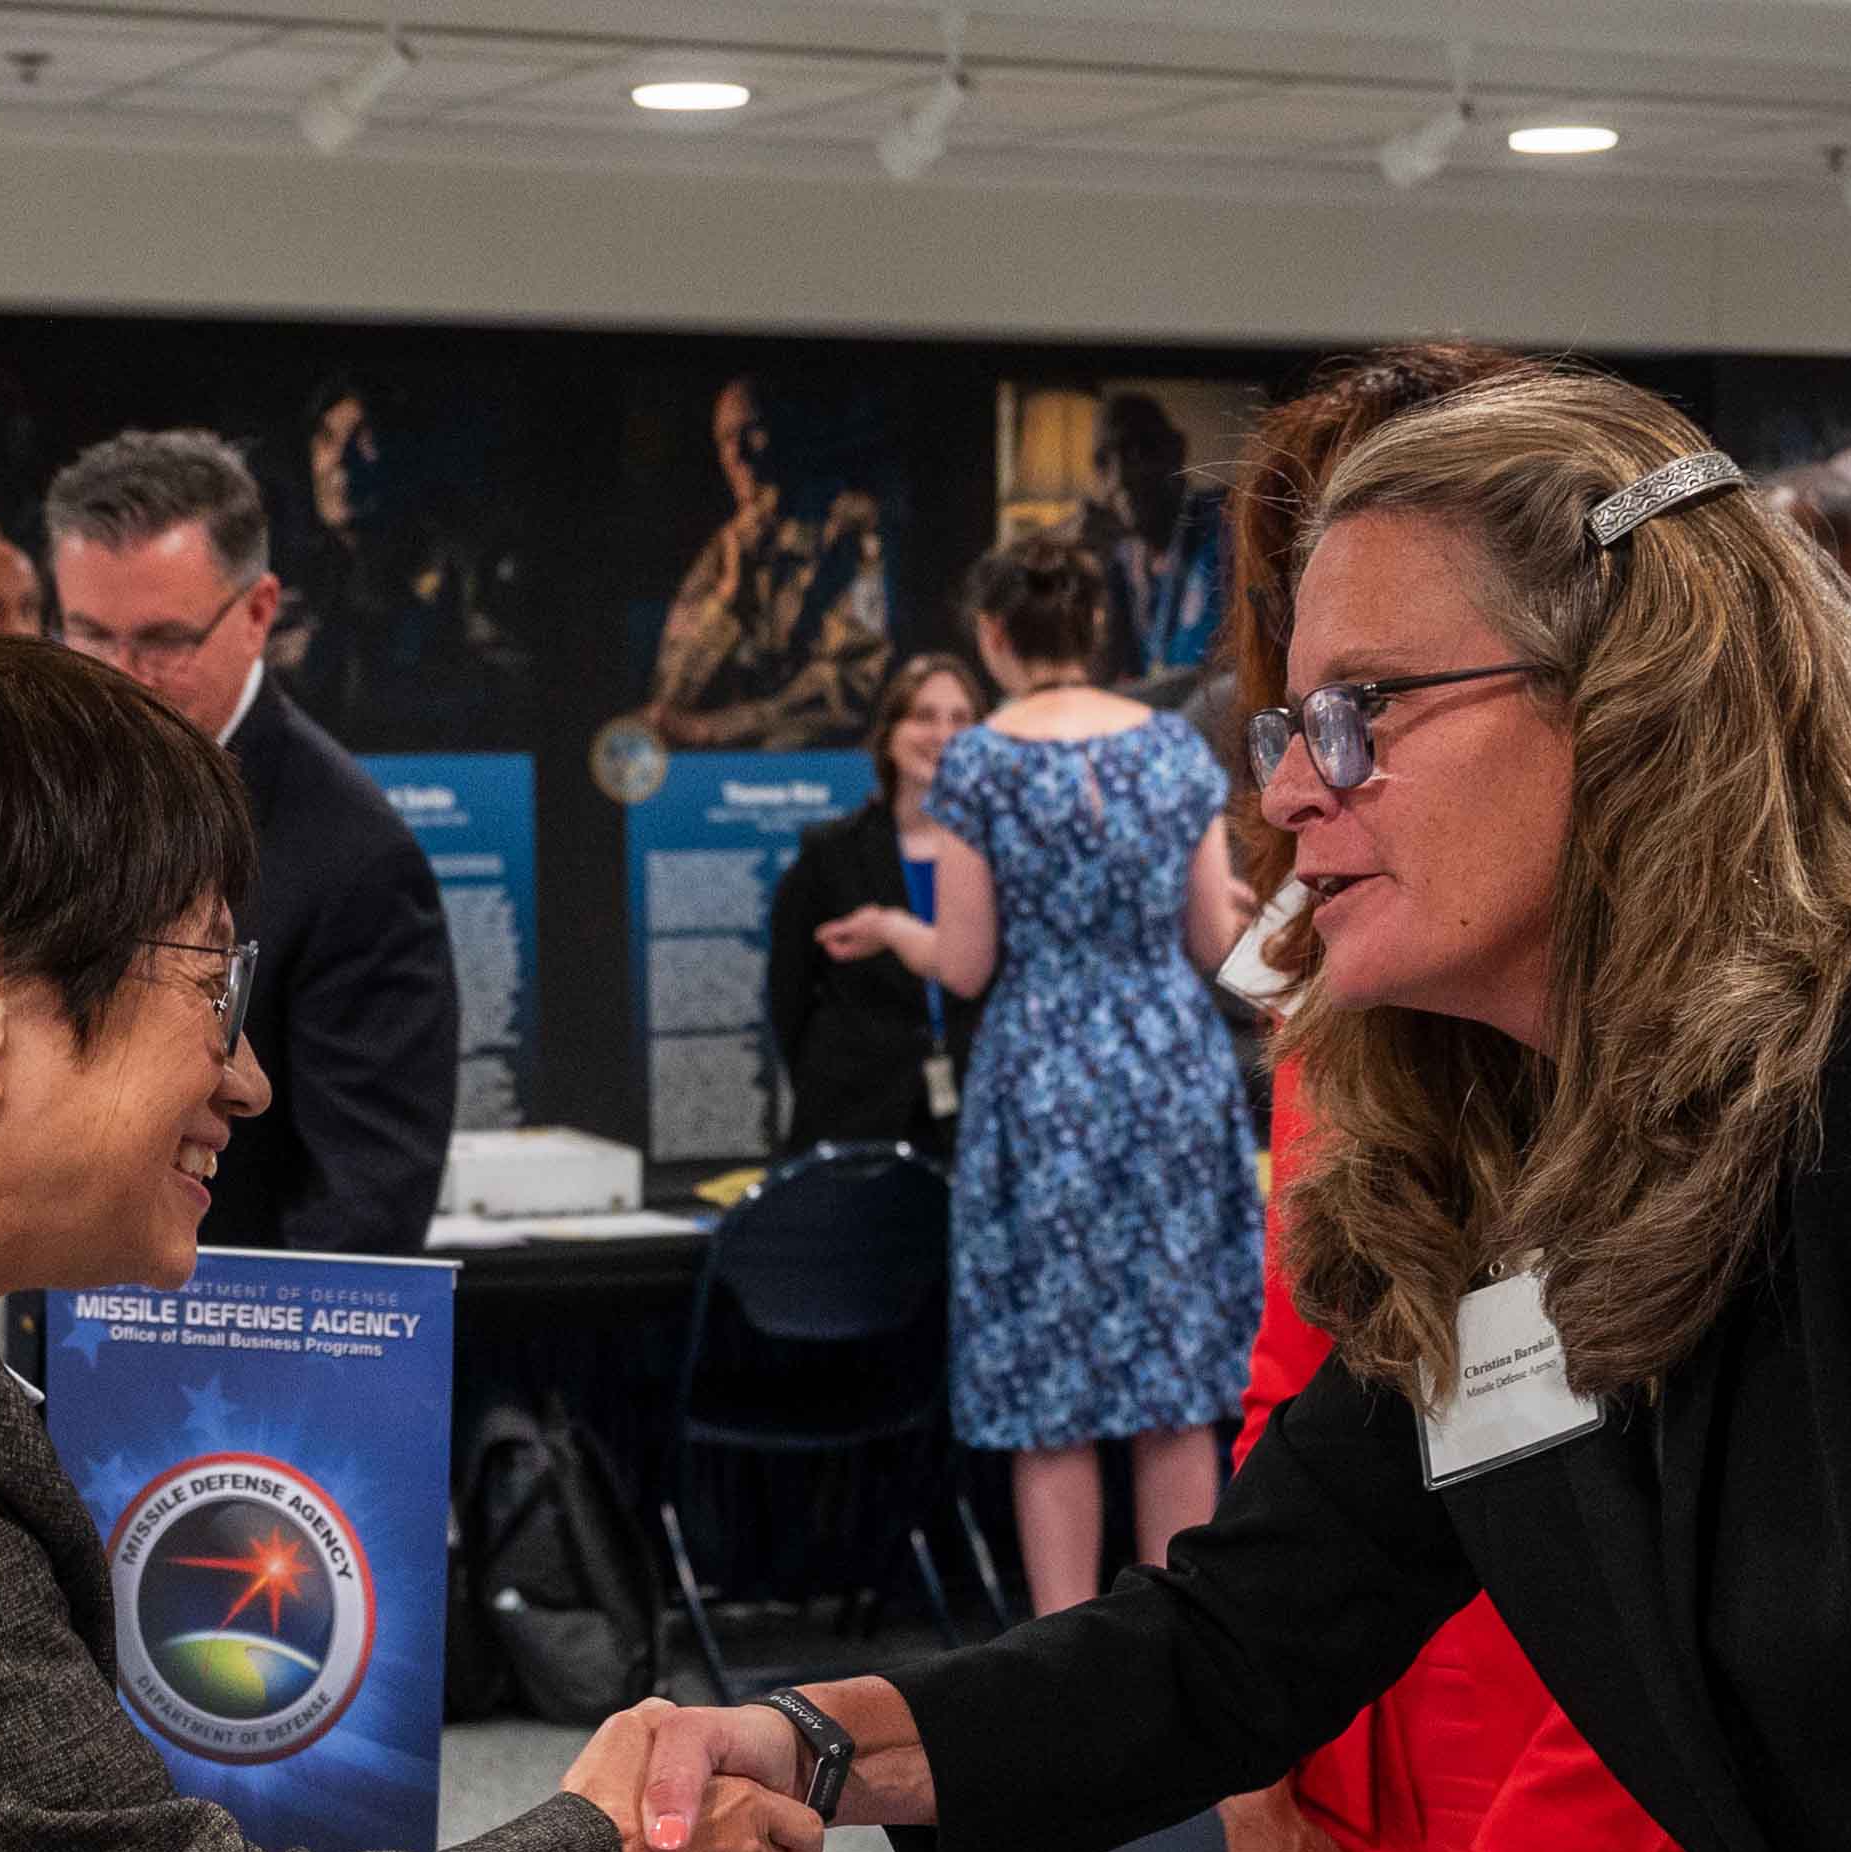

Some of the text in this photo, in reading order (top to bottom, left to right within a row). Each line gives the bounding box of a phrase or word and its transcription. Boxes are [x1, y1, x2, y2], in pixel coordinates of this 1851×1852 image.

[76, 1294, 421, 1339] MISSILE DEFENSE AGENCY
[110, 1325, 383, 1358] Office of Small Business Programs
[1464, 1355, 1513, 1379] Christina
[121, 1473, 353, 1581] MISSILE DEFENSE AGENCY
